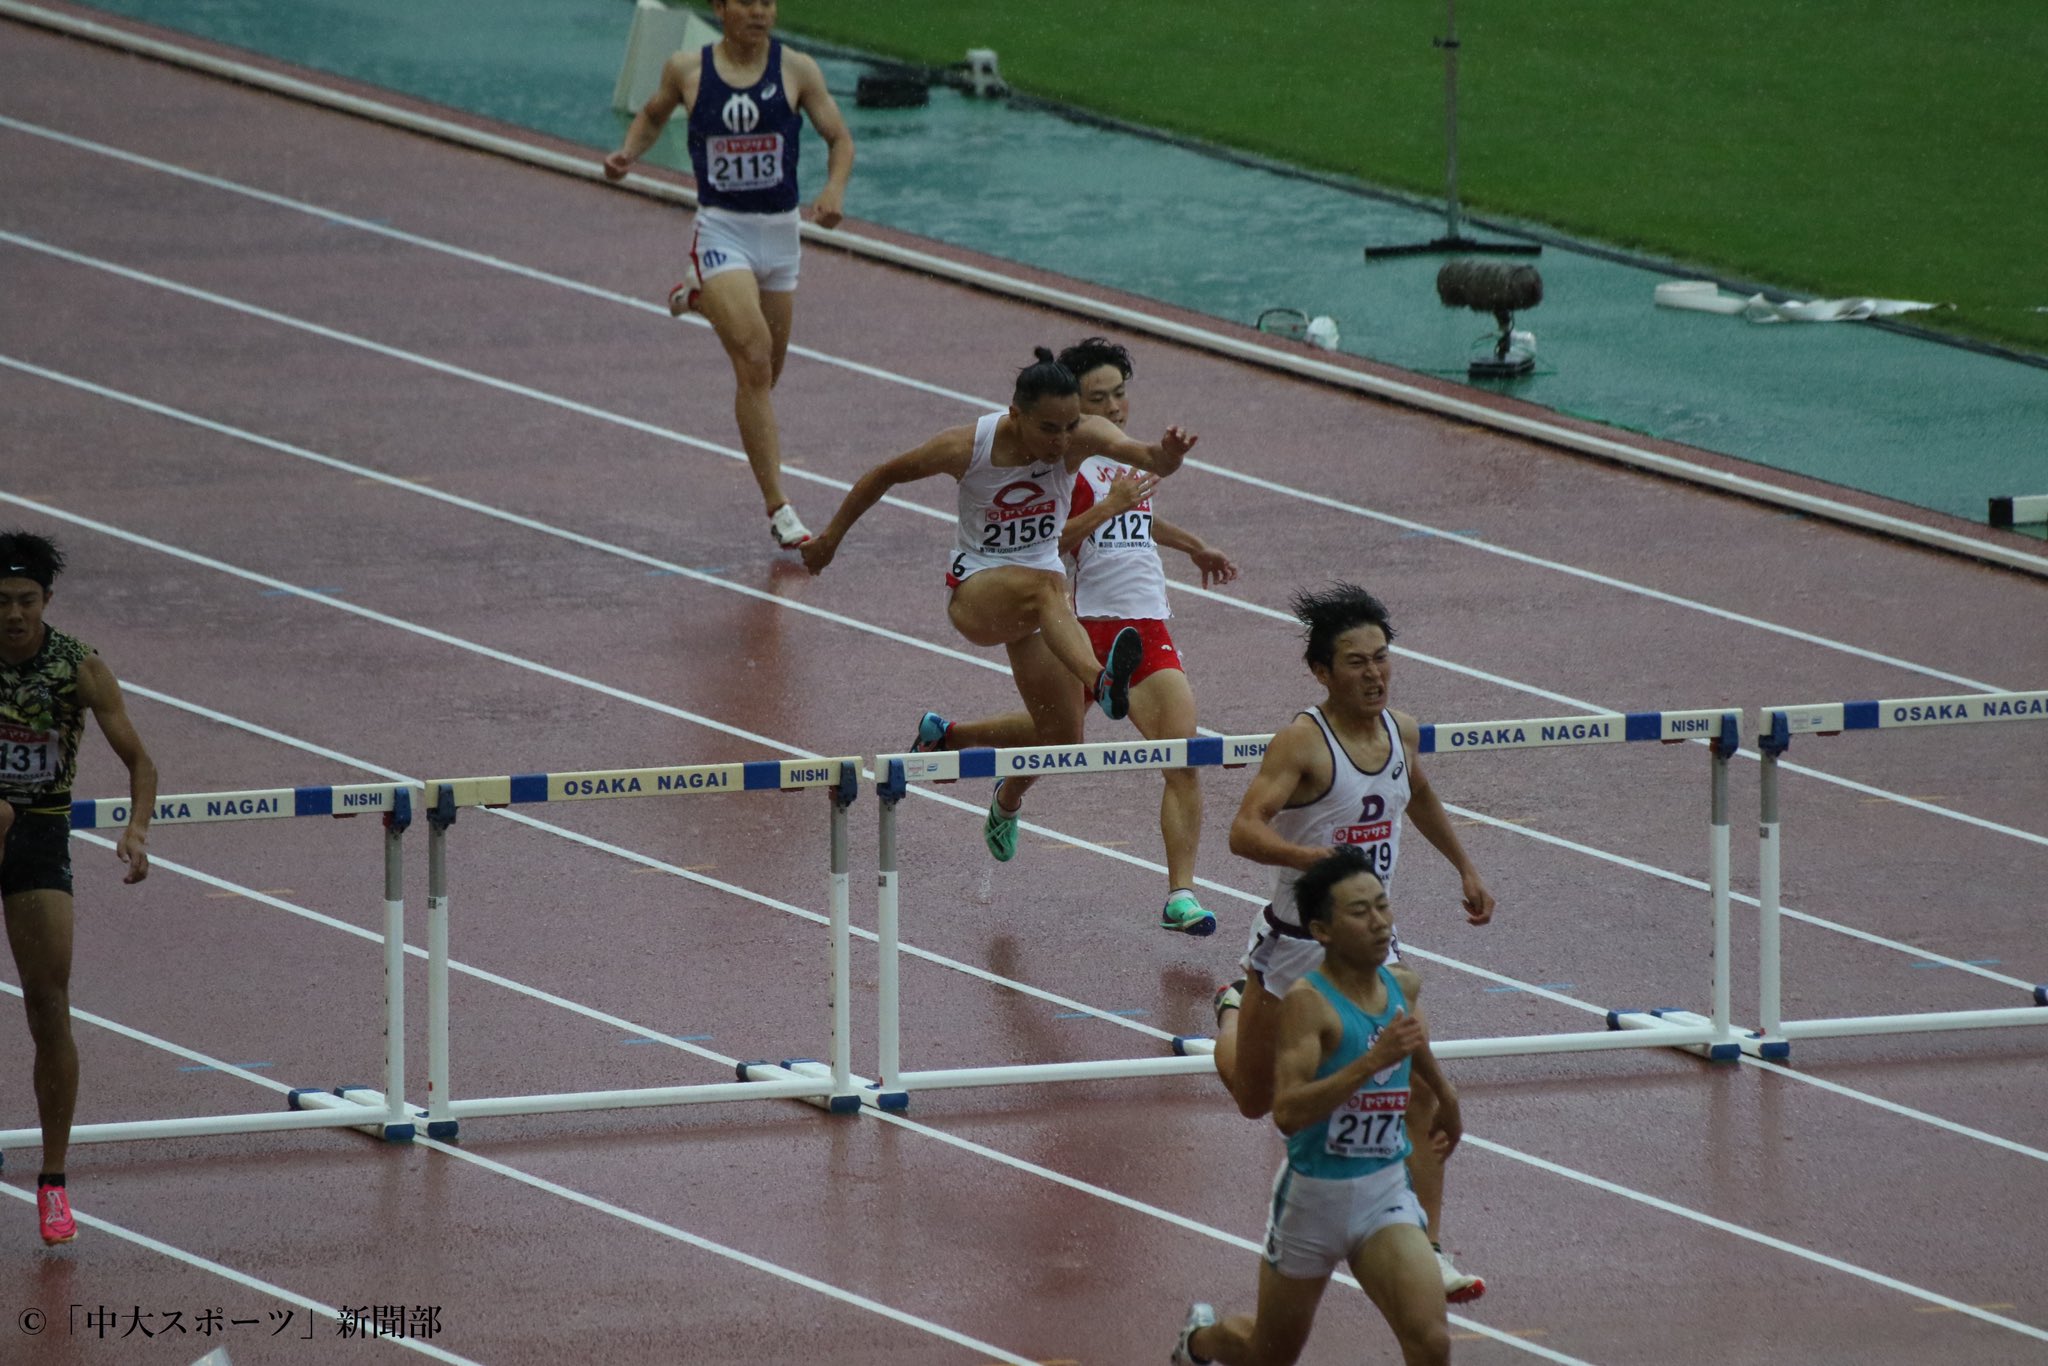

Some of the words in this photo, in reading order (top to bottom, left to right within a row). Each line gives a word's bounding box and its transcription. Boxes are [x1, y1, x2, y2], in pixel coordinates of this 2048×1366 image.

[714, 154, 775, 181] 2113
[983, 515, 1056, 547] 2156
[1102, 513, 1152, 540] 2127
[952, 553, 966, 577] 6
[1893, 704, 1969, 722] OSAKA
[1451, 729, 1526, 747] OSAKA
[1541, 723, 1610, 741] NAGAI
[1671, 719, 1709, 733] NISHI
[0, 742, 48, 773] 131
[1012, 752, 1088, 770] OSAKA
[1103, 747, 1172, 765] NAGAI
[1234, 744, 1268, 757] NISH
[564, 777, 642, 796] OSAKA
[657, 771, 728, 790] NAGAI
[790, 768, 829, 782] NISHI
[112, 803, 191, 823] OKA
[207, 798, 278, 816] NAGAI
[343, 793, 382, 807] NISHI
[1358, 794, 1385, 823] D
[1366, 841, 1392, 872] 19
